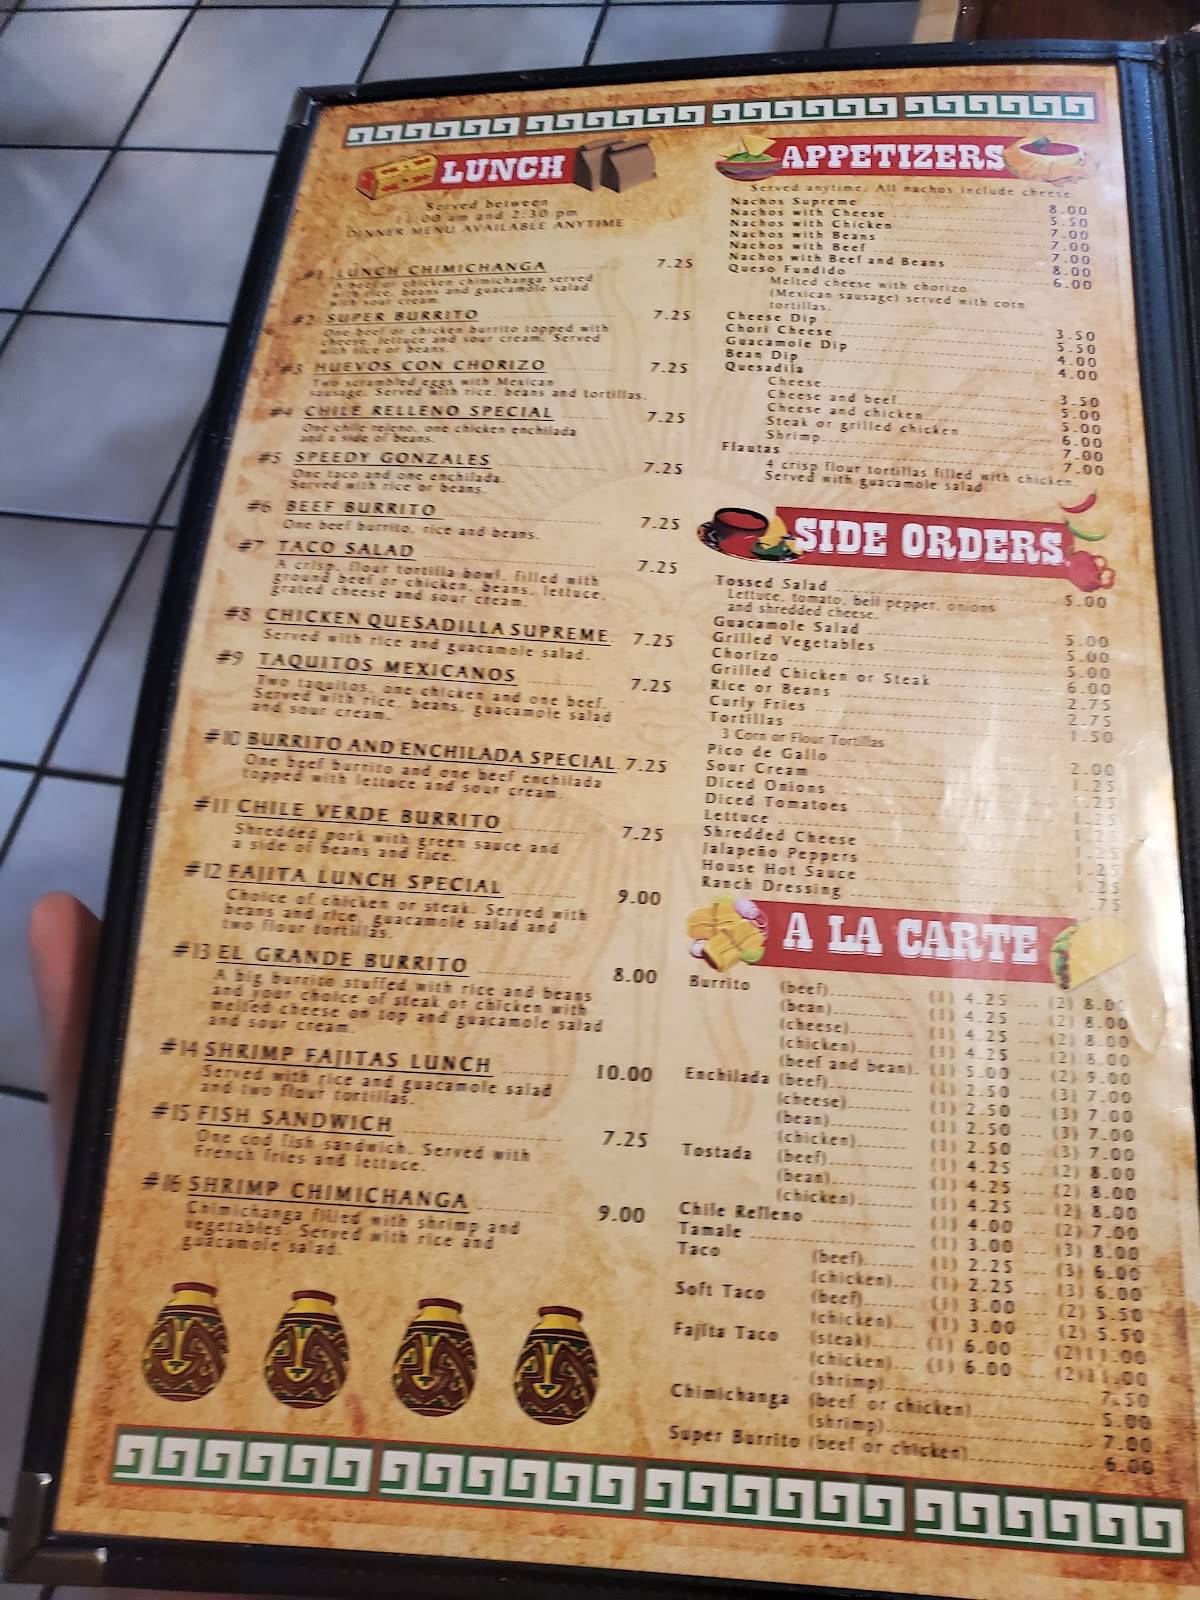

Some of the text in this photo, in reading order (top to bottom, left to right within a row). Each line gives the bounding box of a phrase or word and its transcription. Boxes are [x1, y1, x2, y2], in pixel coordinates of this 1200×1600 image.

[440, 155, 566, 183] LUNCH
[781, 144, 1007, 171] APPETIZERS
[730, 197, 1088, 215] Nachos Supreme 8.00
[730, 208, 1088, 228] Nachos with Cheese 5.50
[337, 258, 693, 277] LUNCH CHIMICHANGA 7.25
[729, 265, 846, 276] Queso Fundido
[327, 309, 691, 324] SUPER BURRITO 7.25
[727, 312, 1095, 341] Cheese Dip 3.50
[726, 324, 1096, 354] Chori Cheese 5.50
[726, 337, 1097, 368] Guacamole Dip 4.00
[316, 359, 688, 373] HUEVOS CON CHORIZO 7.25
[304, 405, 686, 424] CHILE RELLENO SPECIAL 7.25
[294, 452, 684, 475] SPEEDY GONZALES 7.25
[283, 519, 313, 529] One
[320, 519, 350, 531] beef
[424, 525, 451, 535] rice
[459, 526, 489, 537] and
[286, 501, 681, 530] BEEF BURRITO 7.25
[795, 517, 1065, 565] SIDE ORDERS
[278, 541, 678, 574] TACO SALAD 7.25
[717, 575, 1107, 609] Tossed Salad 5.00
[264, 608, 674, 647] CHICKEN QUESADILLA SUPREME 7.25
[713, 616, 1109, 648] Guacamole Salad 5.00
[712, 648, 779, 662] Chorizo
[259, 653, 672, 692] TAQUITOS MEXICANOS 7.25
[712, 664, 1111, 696] Grilled Chicken or Steak 6.00
[711, 680, 1111, 711] Rice or Beans 2.75
[710, 696, 1111, 727] Curly Fries 2.75
[247, 732, 667, 773] BURRITO AND ENCHILADA SPECIAL 7.25
[722, 728, 884, 748] 3 Corn or Flour Tortillas
[707, 744, 828, 762] Pico de Gallo
[707, 760, 808, 777] Sour Cream
[704, 810, 769, 823] Lettuce
[705, 793, 848, 812] Diced Tomatoes
[237, 800, 664, 841] CHILE VERDE BURRITO 7.25
[704, 826, 857, 846] Shredded Cheese
[788, 846, 858, 864] Peppers
[228, 864, 305, 884] FAJITA
[319, 870, 396, 889] LUNCH
[408, 874, 502, 894] SPECIAL
[618, 889, 661, 906] 9.00
[701, 876, 840, 898] Ranch Dressing
[783, 913, 1038, 964] A LA CARTE
[218, 944, 244, 961] EL
[256, 947, 351, 967] GRANDE
[364, 953, 469, 973] BURRITO
[613, 968, 658, 984] 8.00
[690, 974, 750, 991] Burrito
[204, 1041, 293, 1062] SHRIMP
[306, 1048, 399, 1068] FAJITAS
[411, 1054, 492, 1074] LUNCH
[598, 1064, 653, 1083] 10.00
[685, 1067, 1009, 1099] Enchilada 2.50
[197, 1105, 250, 1123] FISH
[263, 1109, 393, 1133] SANDWICH
[603, 1130, 648, 1148] 7.25
[683, 1143, 1010, 1175] Tostada 4.25
[188, 1175, 278, 1197] SHRIMP
[291, 1182, 468, 1210] CHIMICHANGA
[599, 1206, 645, 1224] 9.00
[679, 1201, 1013, 1234] Chile Relleno 4.00
[679, 1221, 1013, 1253] Tamale 3.00
[677, 1242, 1013, 1274] Taco 2.25
[675, 1281, 765, 1300] Soft Taco
[674, 1322, 779, 1341] Fajita Taco
[670, 1383, 789, 1408] Chimichanga
[669, 1425, 800, 1448] Super Burrito
